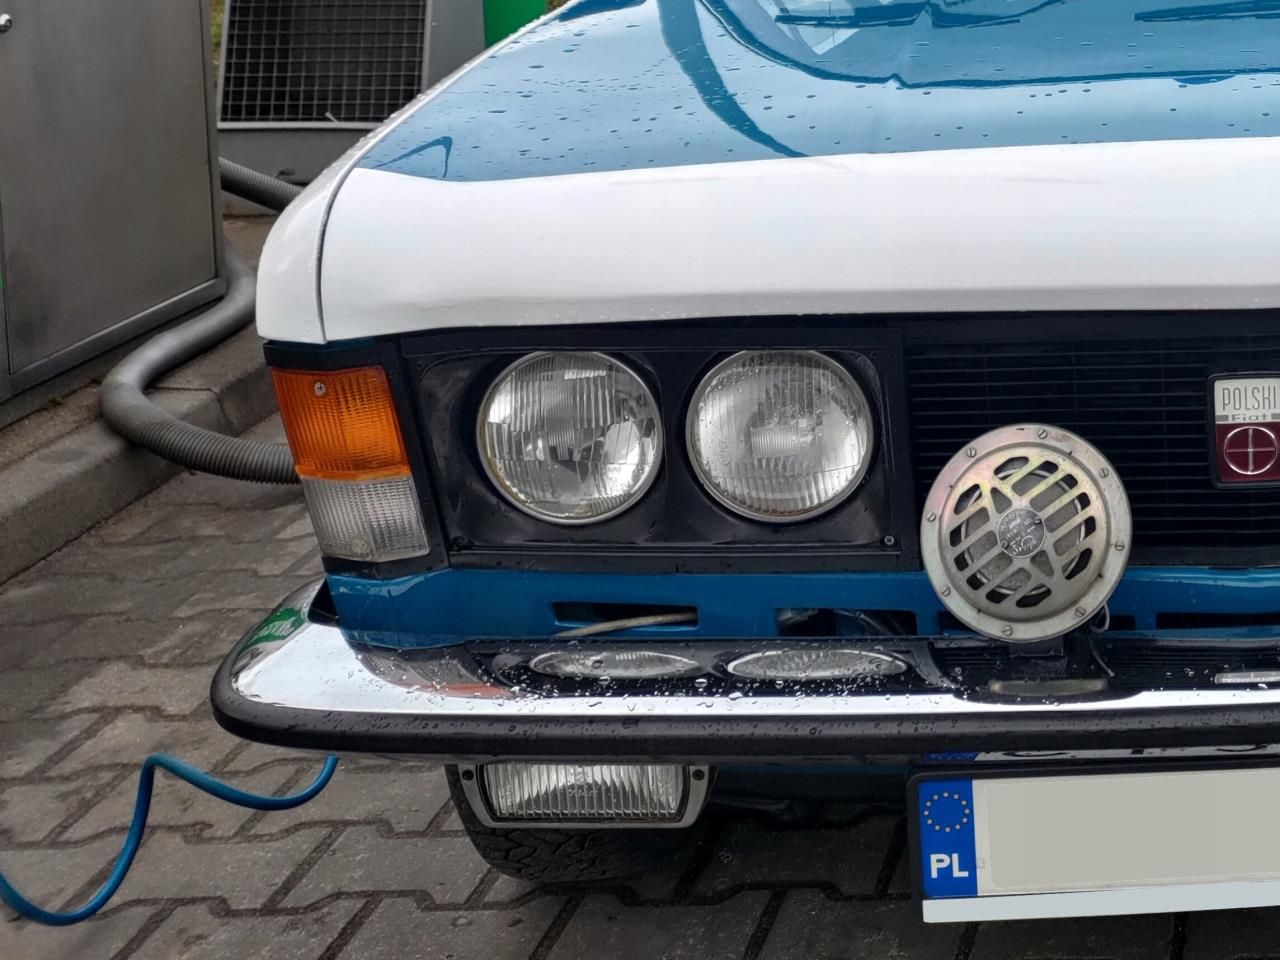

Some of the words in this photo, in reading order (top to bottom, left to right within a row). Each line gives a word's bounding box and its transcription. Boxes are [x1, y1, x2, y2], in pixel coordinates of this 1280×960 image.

[1222, 385, 1277, 411] POLSKI
[1231, 412, 1270, 421] Fiat
[930, 853, 969, 878] PL
